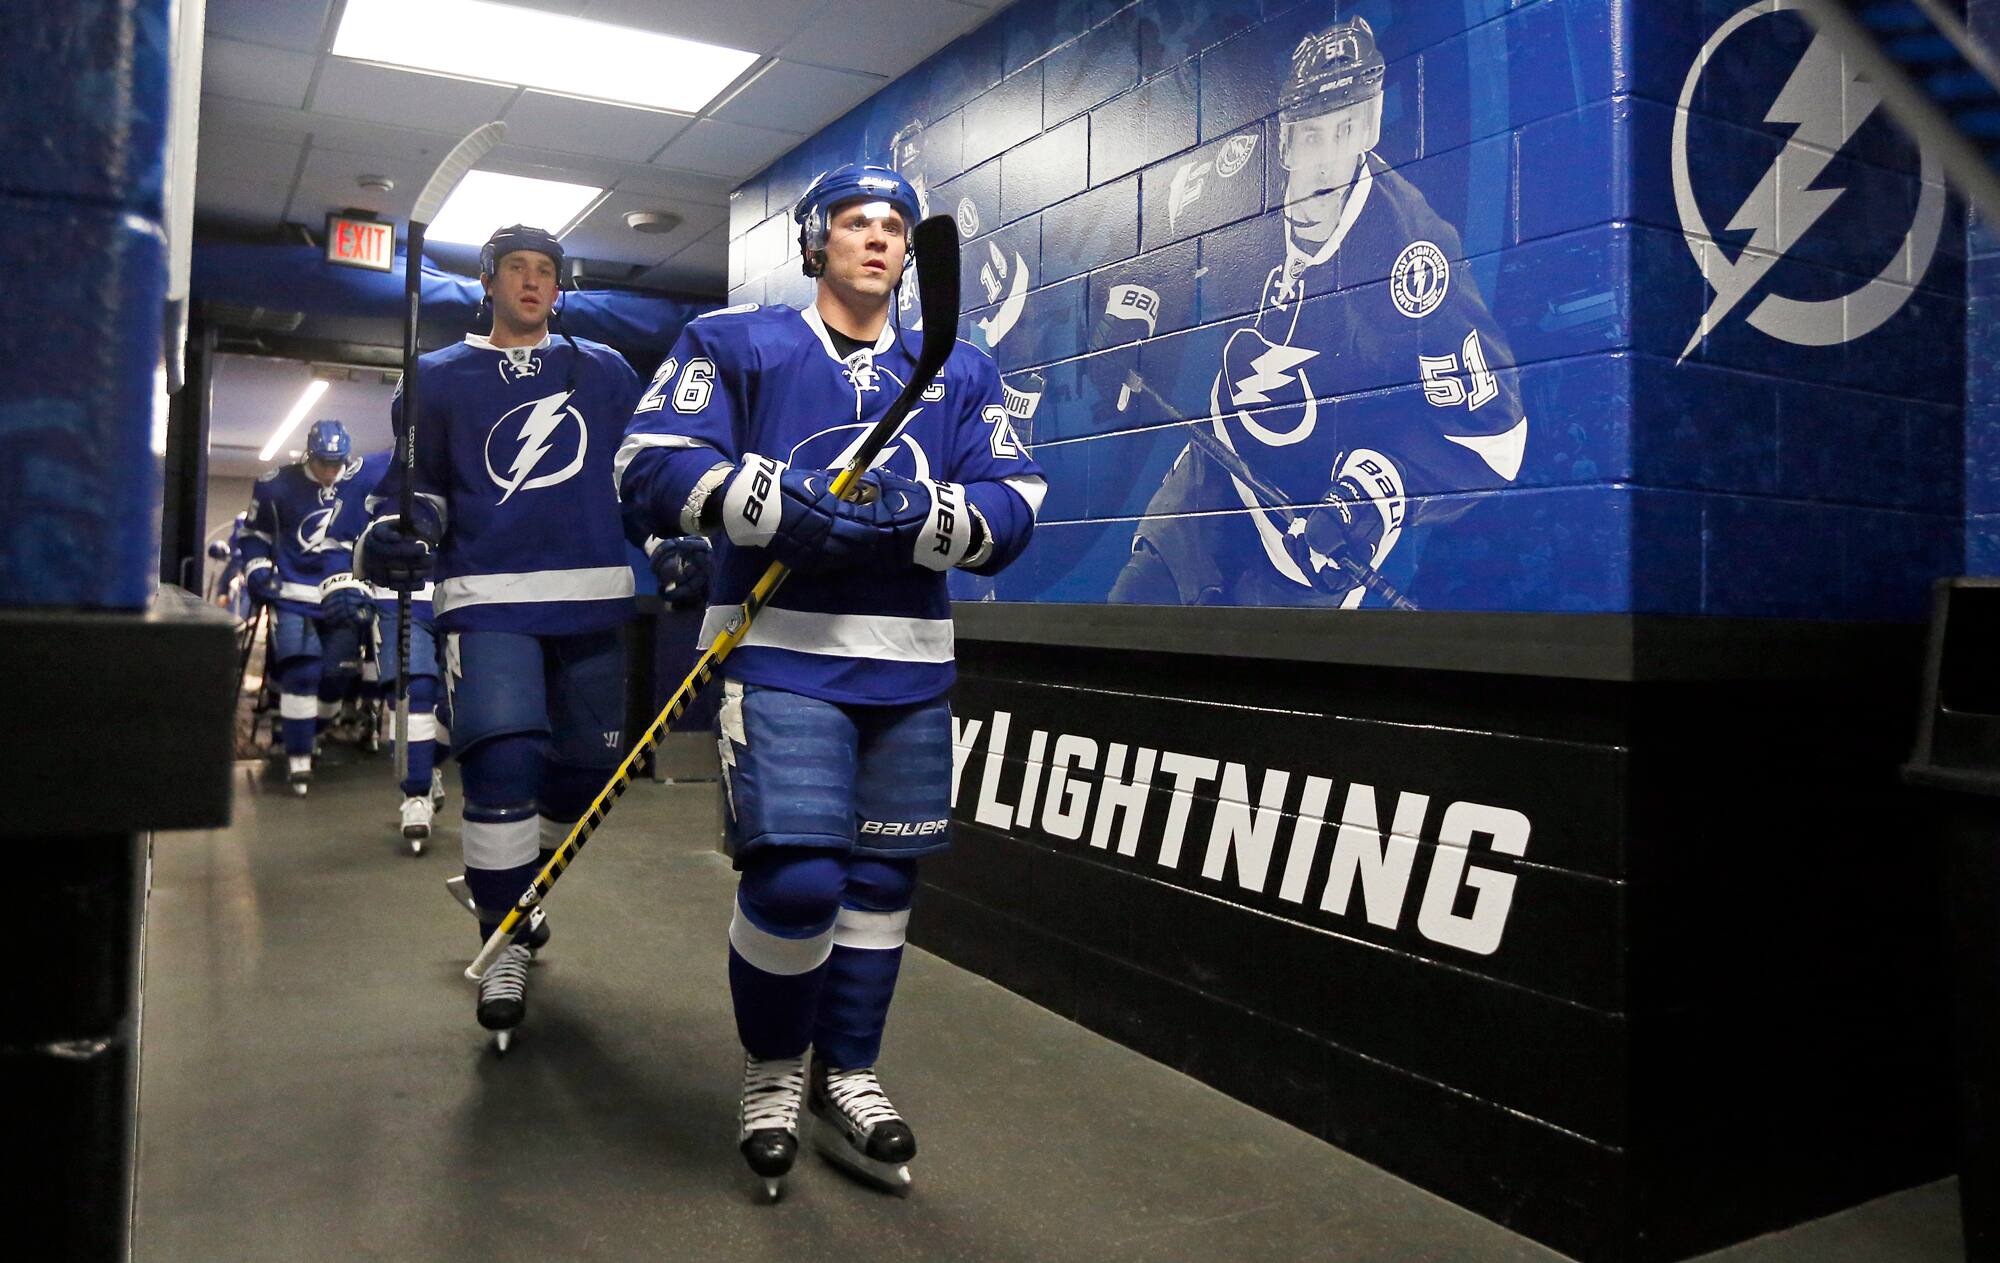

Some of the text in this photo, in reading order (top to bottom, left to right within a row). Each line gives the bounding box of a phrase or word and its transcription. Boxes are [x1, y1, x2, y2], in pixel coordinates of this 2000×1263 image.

[1325, 38, 1347, 59] 51
[336, 219, 385, 262] EXIT
[634, 357, 715, 414] 26
[1419, 329, 1498, 411] 51
